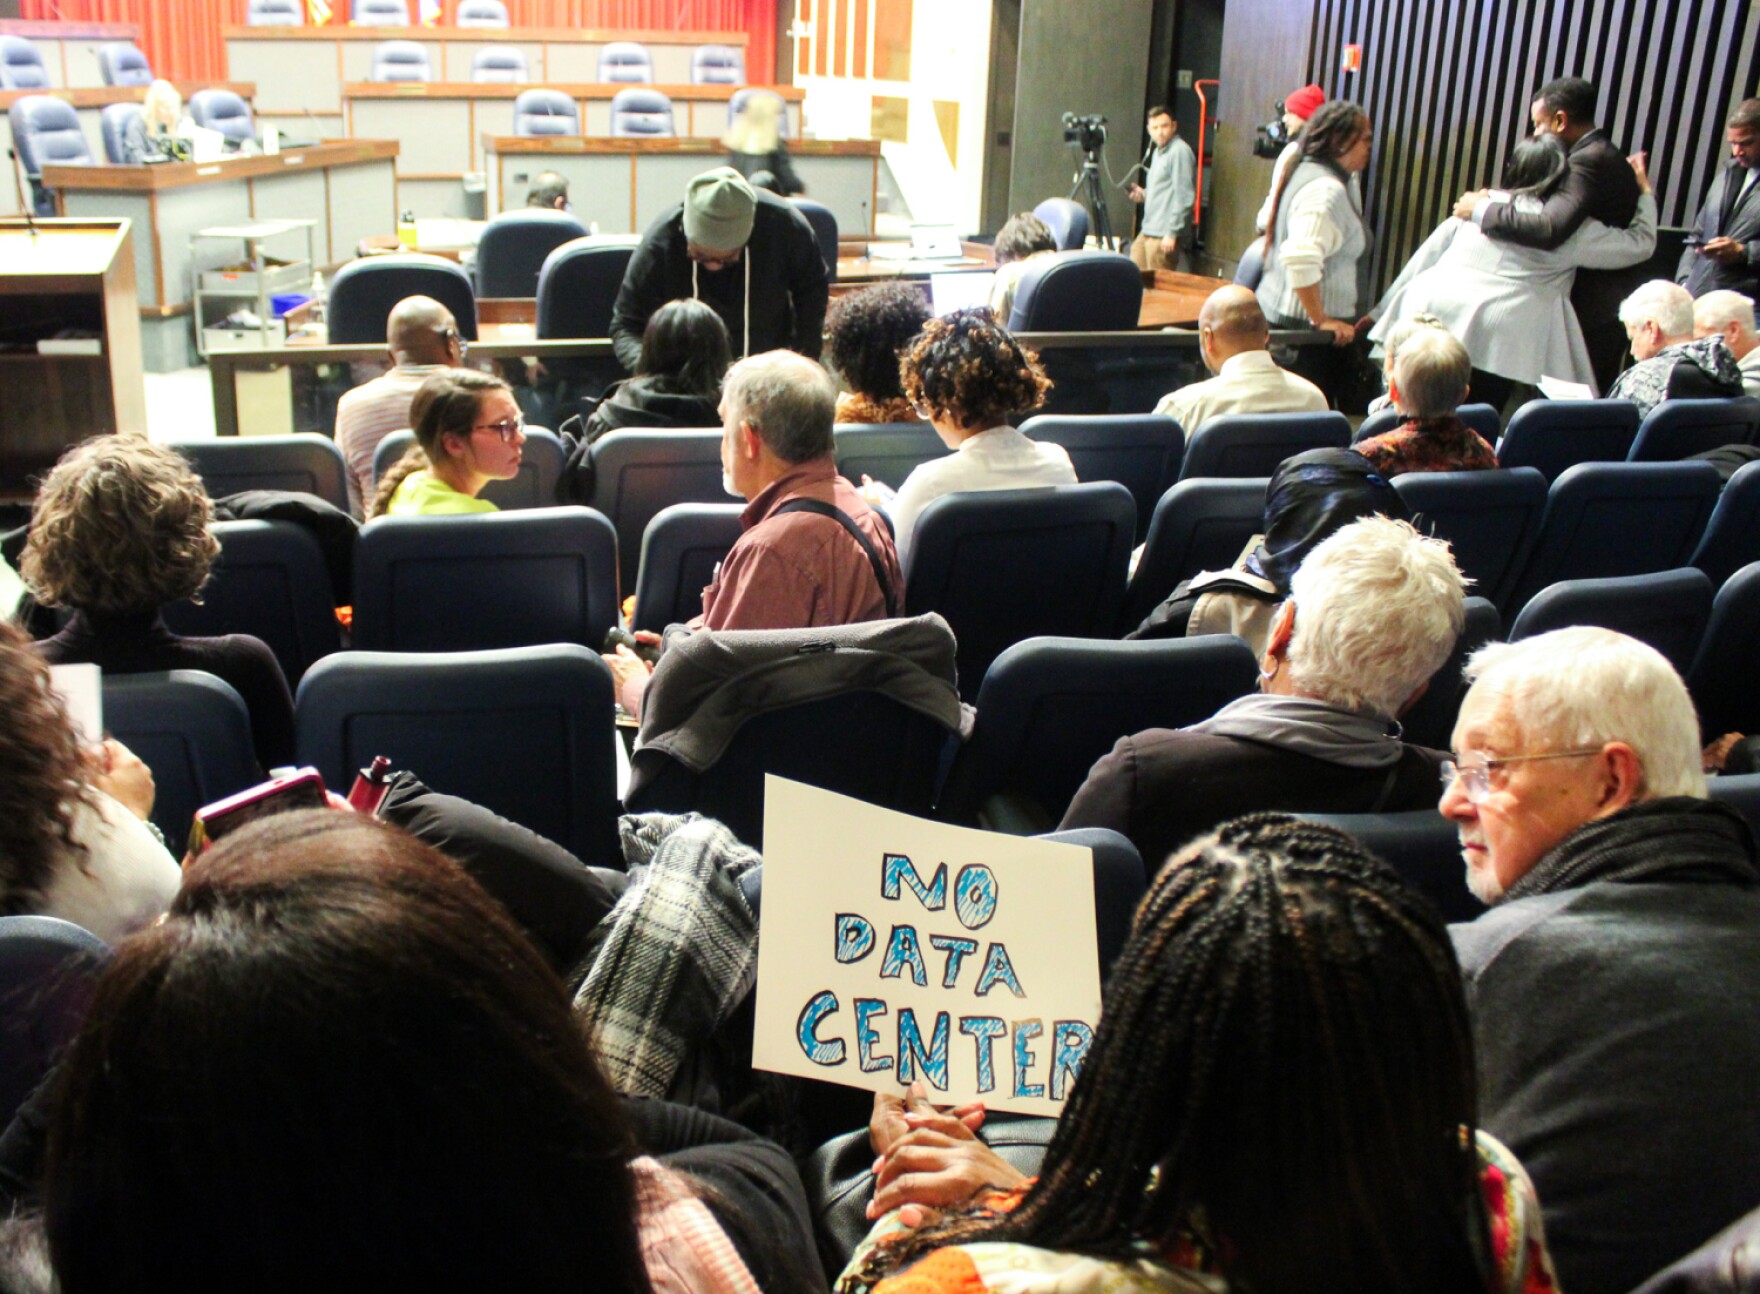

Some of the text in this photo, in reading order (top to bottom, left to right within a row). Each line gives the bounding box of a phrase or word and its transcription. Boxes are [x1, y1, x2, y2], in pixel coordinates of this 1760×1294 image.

[881, 853, 998, 930] NO
[835, 912, 1027, 998] DATA
[796, 990, 1096, 1101] CENTER
